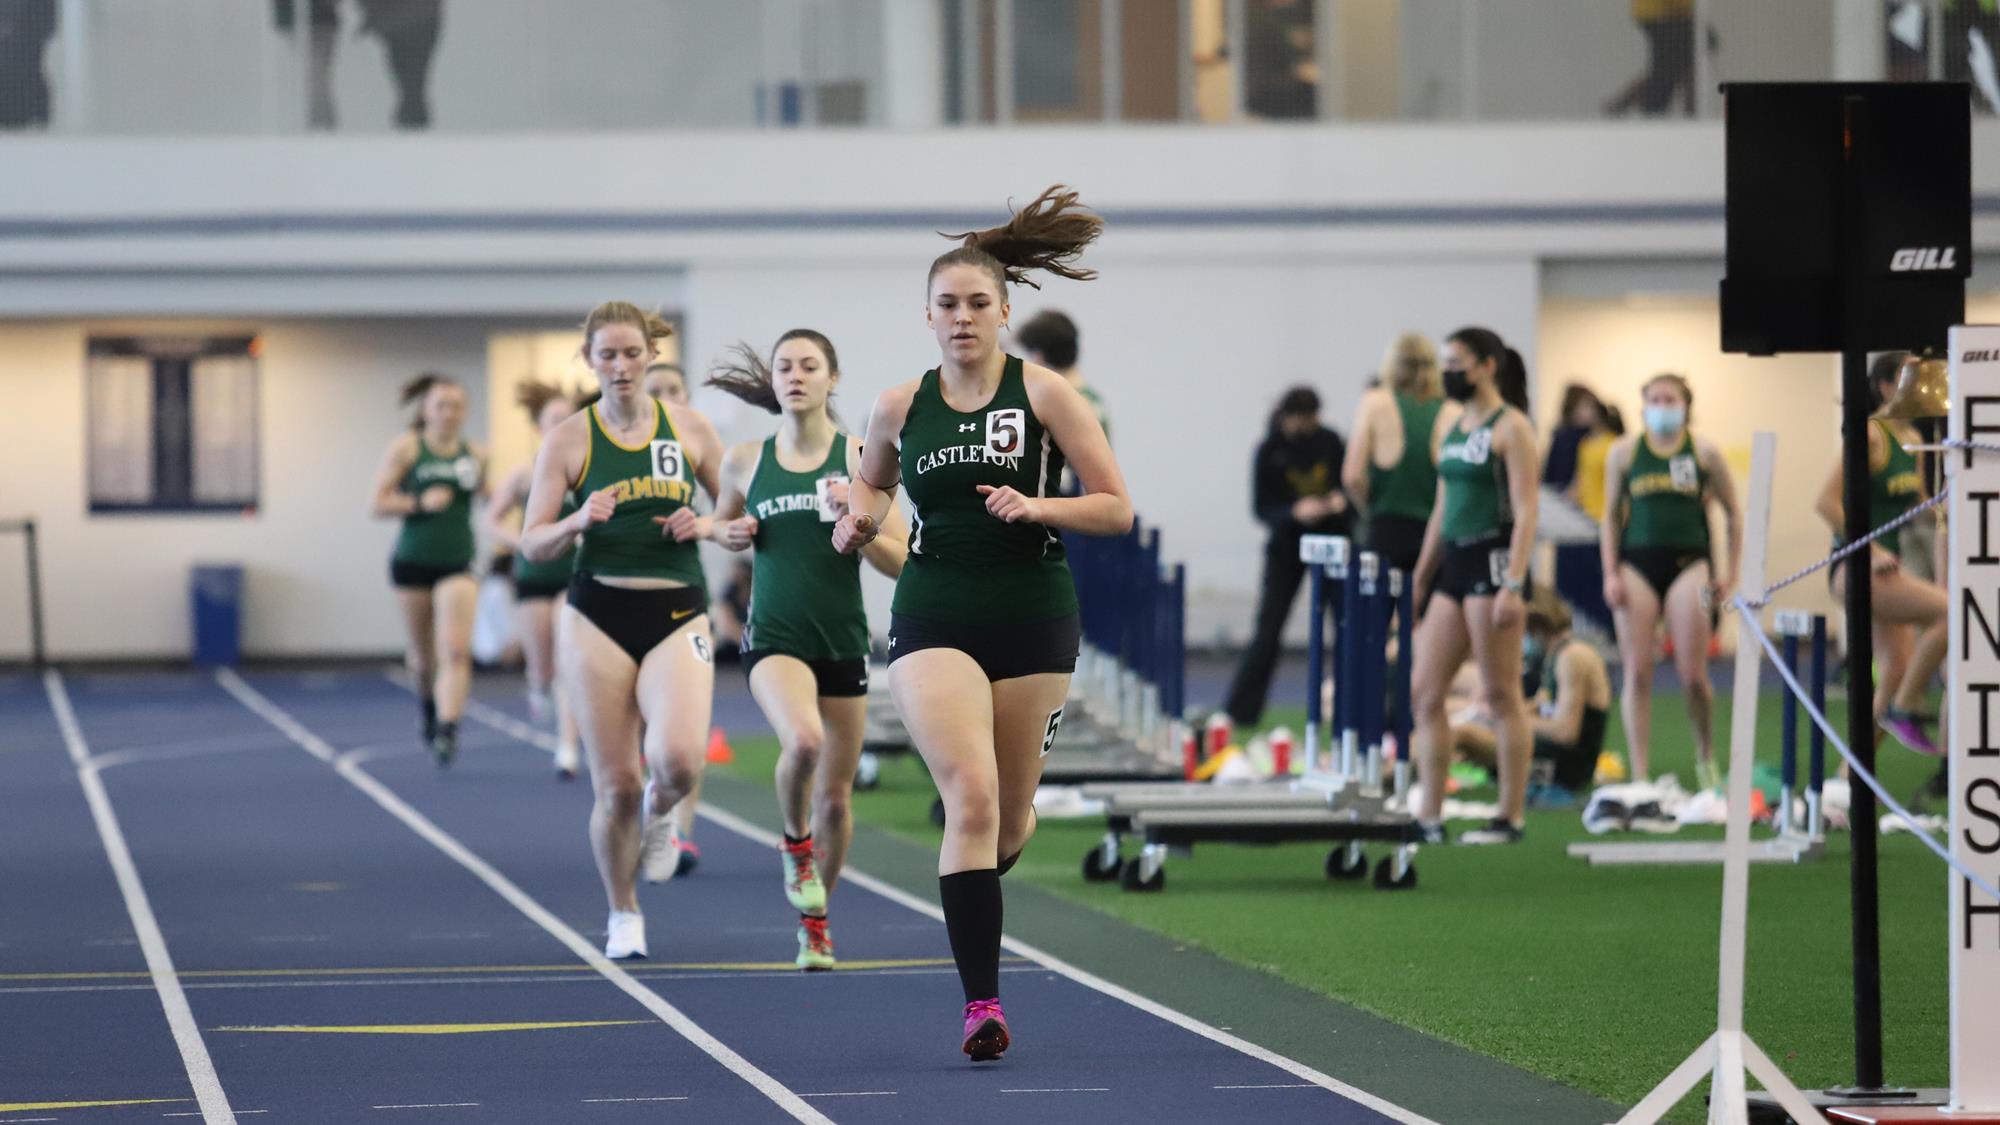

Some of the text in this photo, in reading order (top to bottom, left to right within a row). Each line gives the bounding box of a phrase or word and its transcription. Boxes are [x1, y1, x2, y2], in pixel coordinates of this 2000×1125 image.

[1890, 247, 1956, 271] GILL
[1962, 349, 2000, 363] GILL
[991, 412, 1018, 453] 5
[657, 443, 678, 477] 6
[693, 635, 711, 662] 6
[1043, 709, 1062, 752] 5
